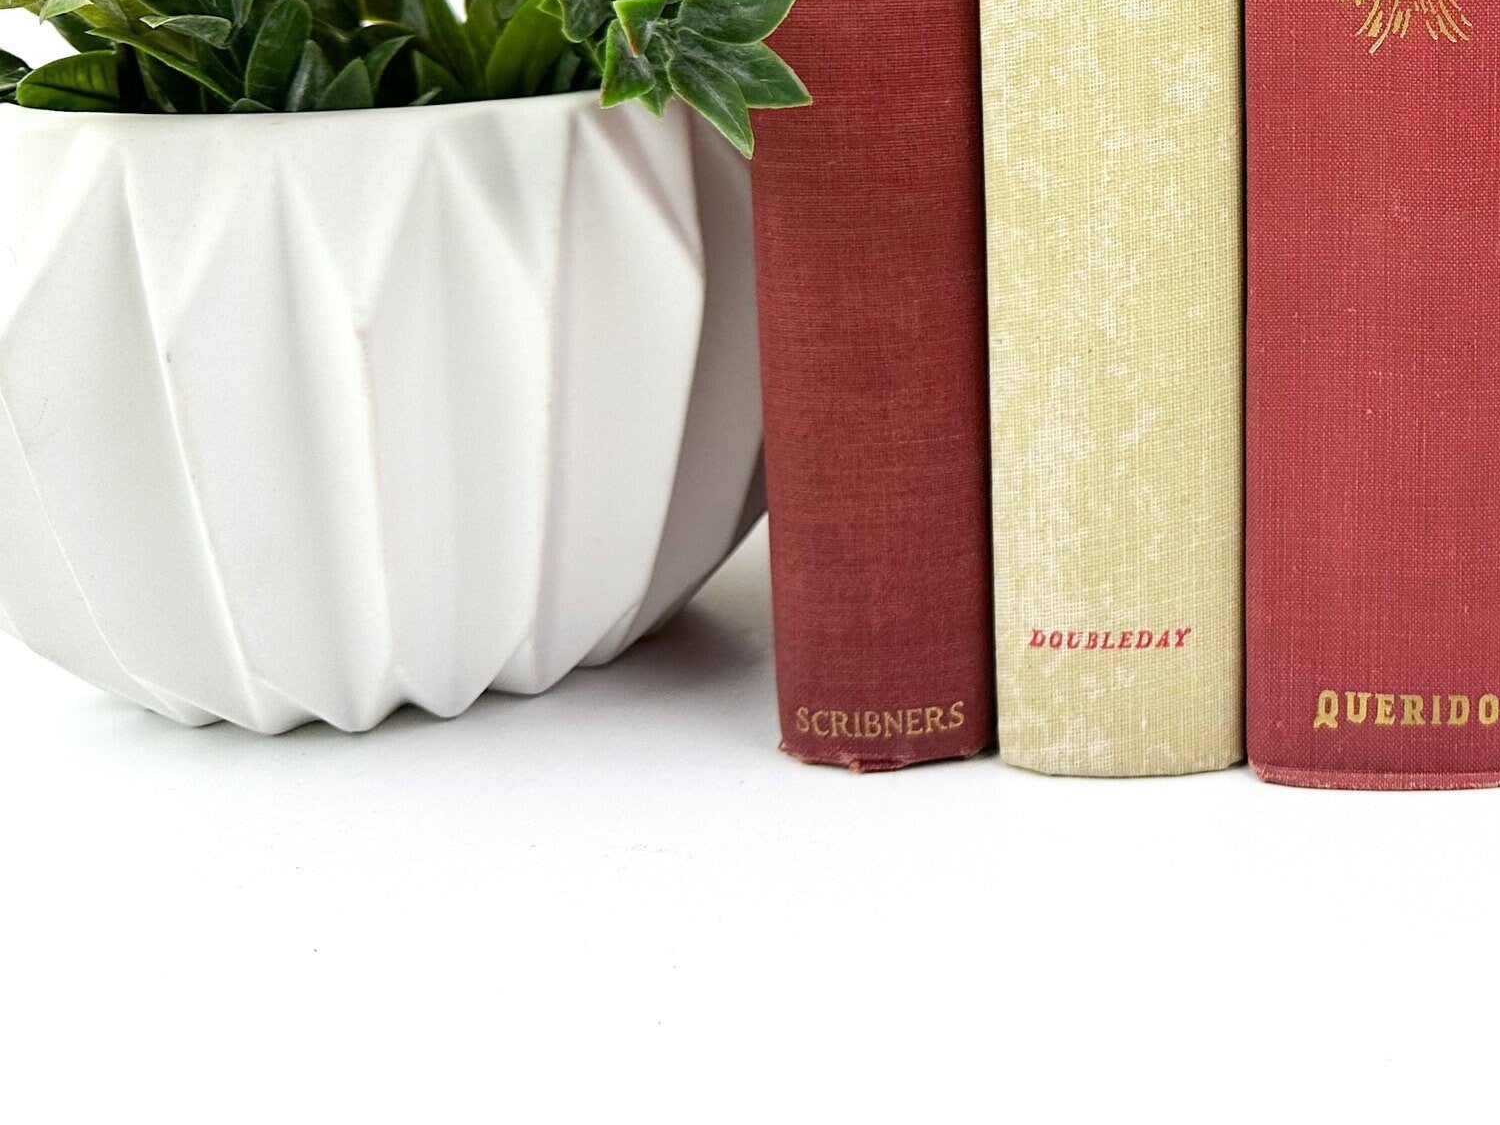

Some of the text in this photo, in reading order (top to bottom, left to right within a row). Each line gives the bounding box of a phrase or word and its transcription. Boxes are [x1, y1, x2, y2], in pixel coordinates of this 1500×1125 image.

[1029, 627, 1192, 650] DOUBLEDAY
[796, 700, 965, 739] SCRIBNERS
[1313, 690, 1500, 730] QUERIDO
